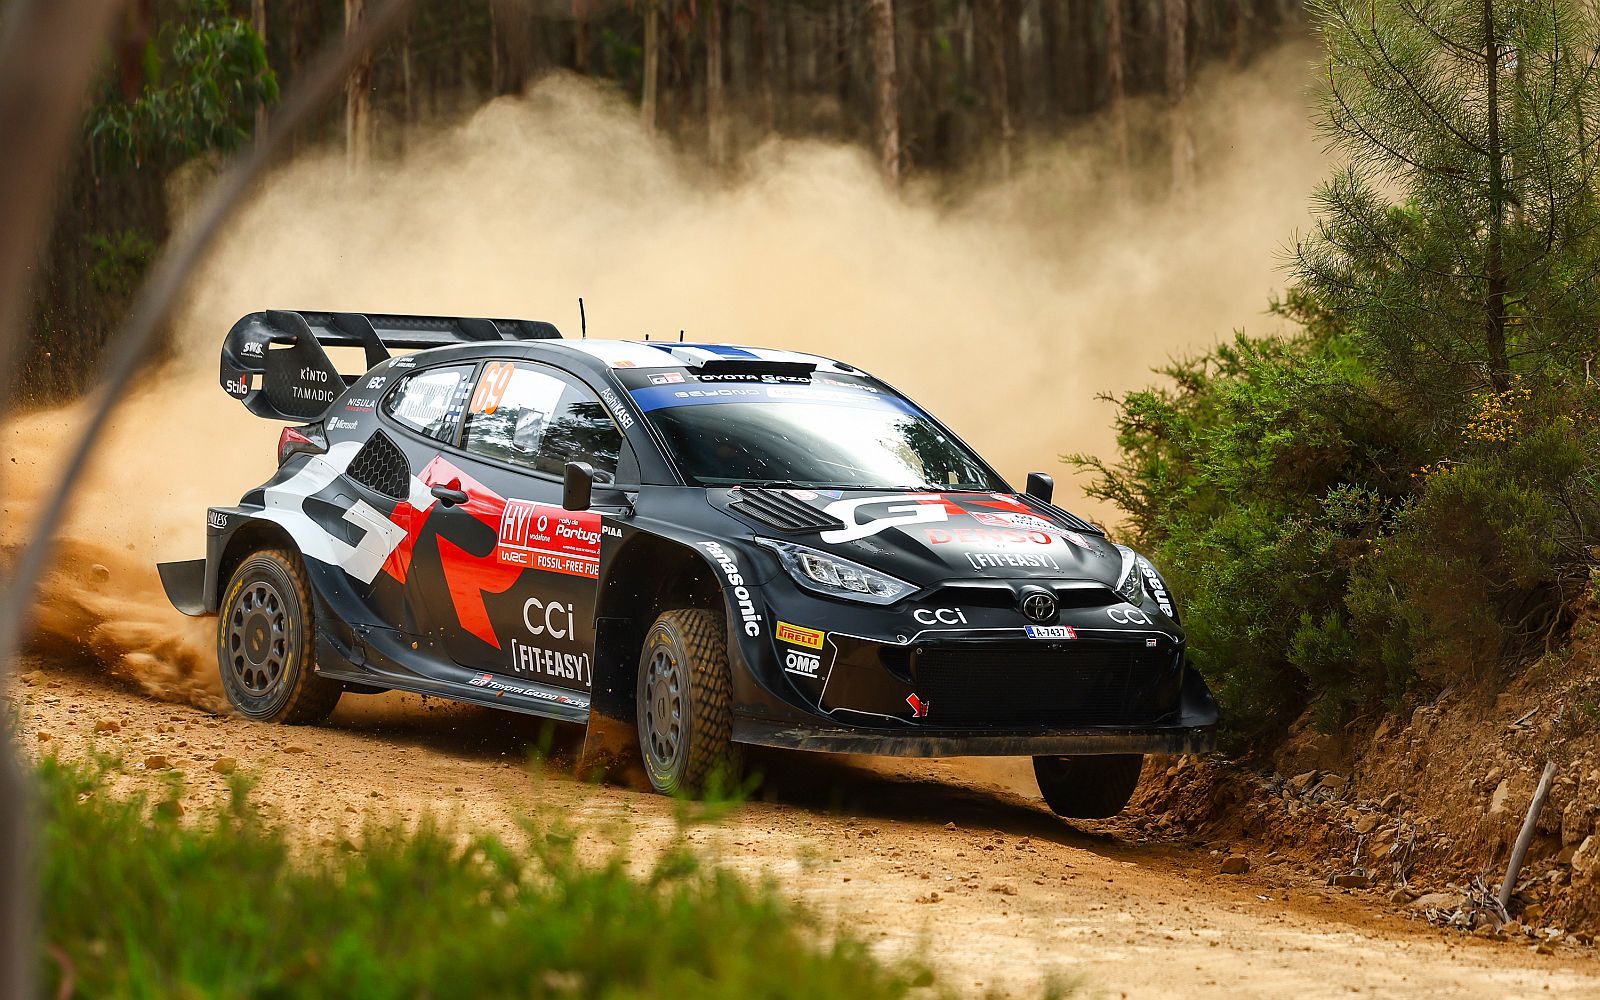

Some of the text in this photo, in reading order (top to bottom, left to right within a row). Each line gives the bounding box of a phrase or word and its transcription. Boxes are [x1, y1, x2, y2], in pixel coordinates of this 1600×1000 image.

[226, 376, 248, 394] Stilo
[688, 373, 759, 383] TOYOTA
[292, 387, 334, 402] TAMADIC
[469, 361, 515, 415] 69
[674, 388, 761, 399] BEYOND
[347, 398, 375, 408] NISULA
[600, 387, 635, 430] AsahiKASEI
[335, 420, 358, 430] Microsoft
[502, 504, 530, 542] HY
[602, 525, 623, 538] PIAA
[530, 533, 551, 543] vodafone
[922, 528, 1053, 546] DENSO
[502, 550, 528, 564] WRC
[538, 555, 584, 574] FOSSIL-FREE
[696, 541, 762, 638] Panasonic
[221, 577, 244, 649] SCORPION
[779, 625, 820, 646] PIRELLI
[785, 653, 820, 674] OMP
[487, 681, 525, 693] TOYOTA
